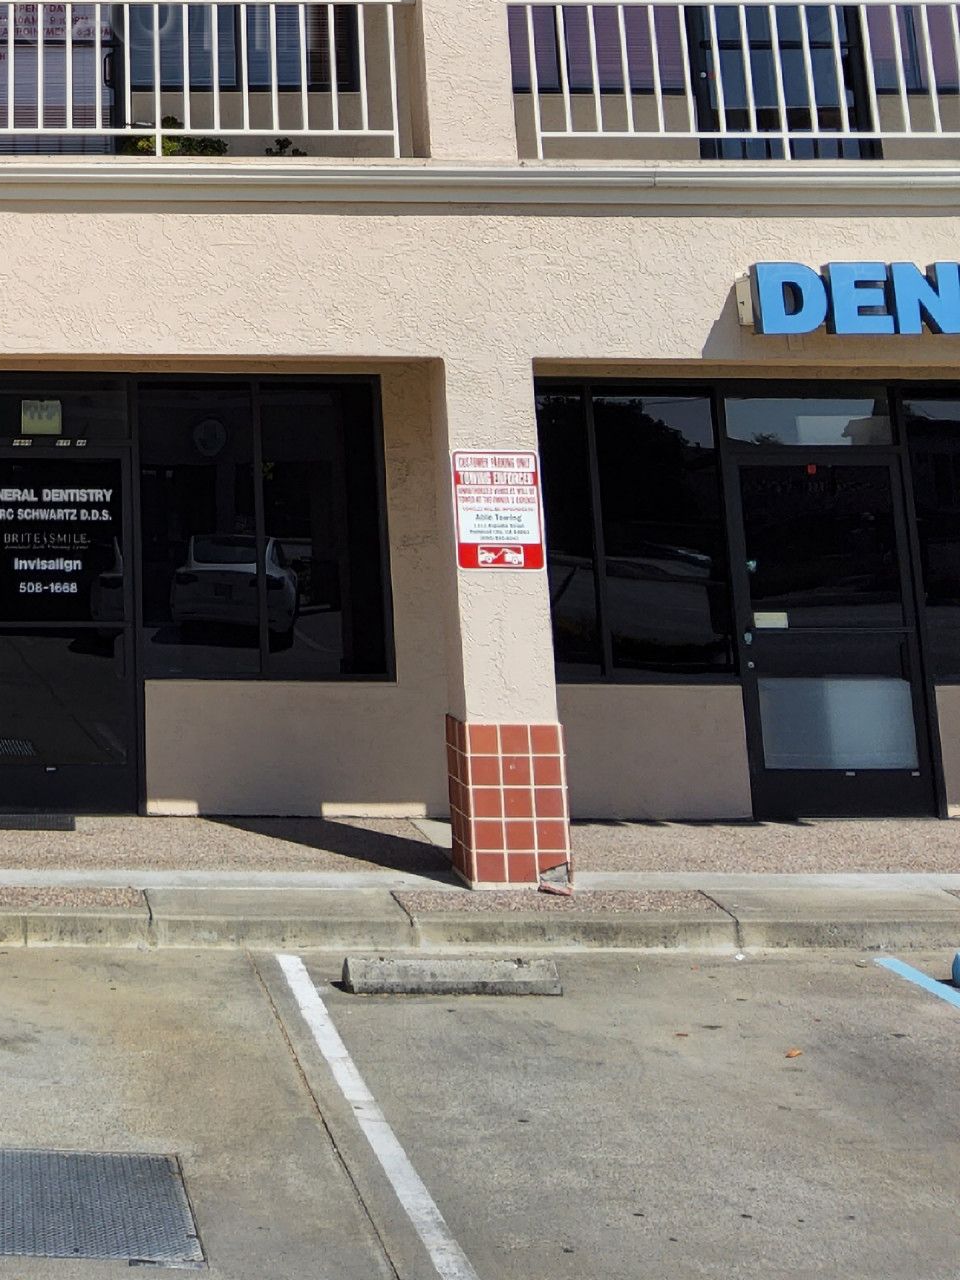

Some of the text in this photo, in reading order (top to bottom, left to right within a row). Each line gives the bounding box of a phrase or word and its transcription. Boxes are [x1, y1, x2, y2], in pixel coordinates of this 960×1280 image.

[42, 488, 113, 502] DENTISTRY
[17, 508, 77, 521] SCHWARTZ
[80, 509, 112, 521] D.D.S.
[14, 557, 82, 572] Invisalign
